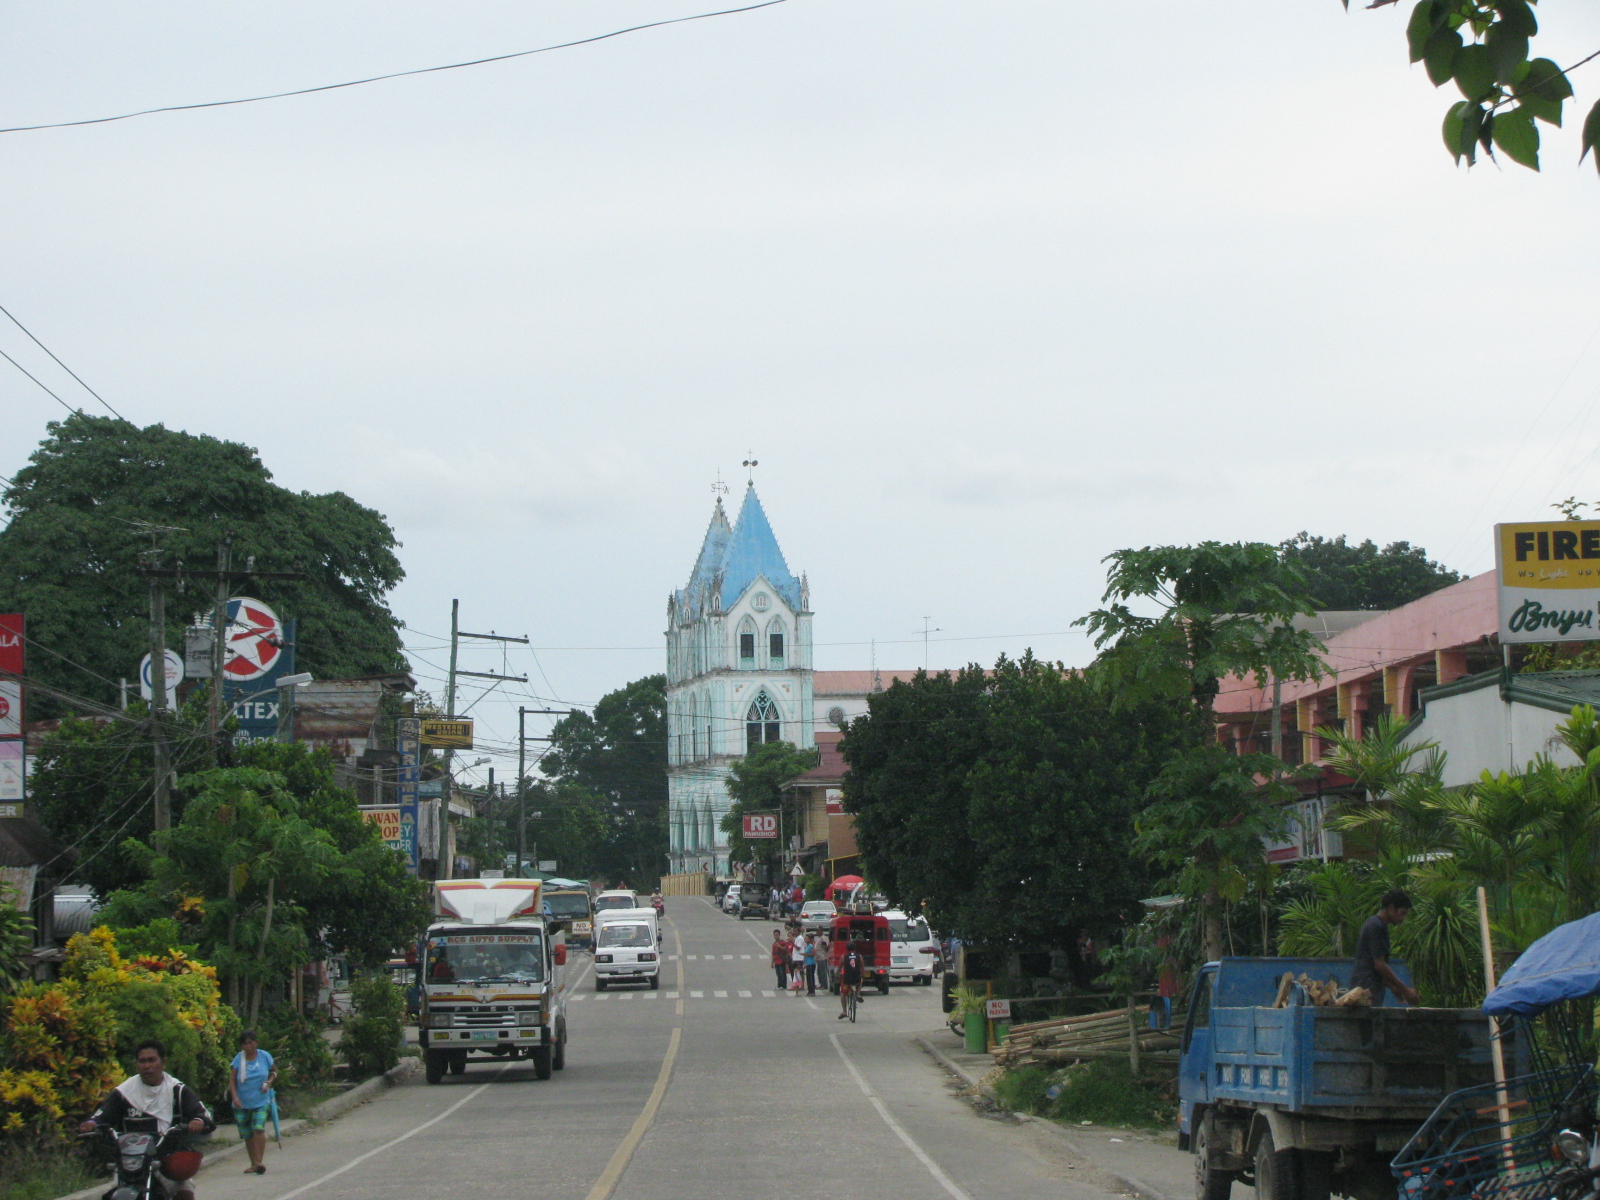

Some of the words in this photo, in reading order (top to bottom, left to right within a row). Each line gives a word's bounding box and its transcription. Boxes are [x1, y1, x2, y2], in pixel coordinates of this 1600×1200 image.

[1514, 529, 1600, 562] FIRE
[232, 701, 280, 719] LTEX
[361, 812, 399, 826] AWAN
[750, 816, 777, 831] RD
[991, 1001, 1003, 1009] NO
